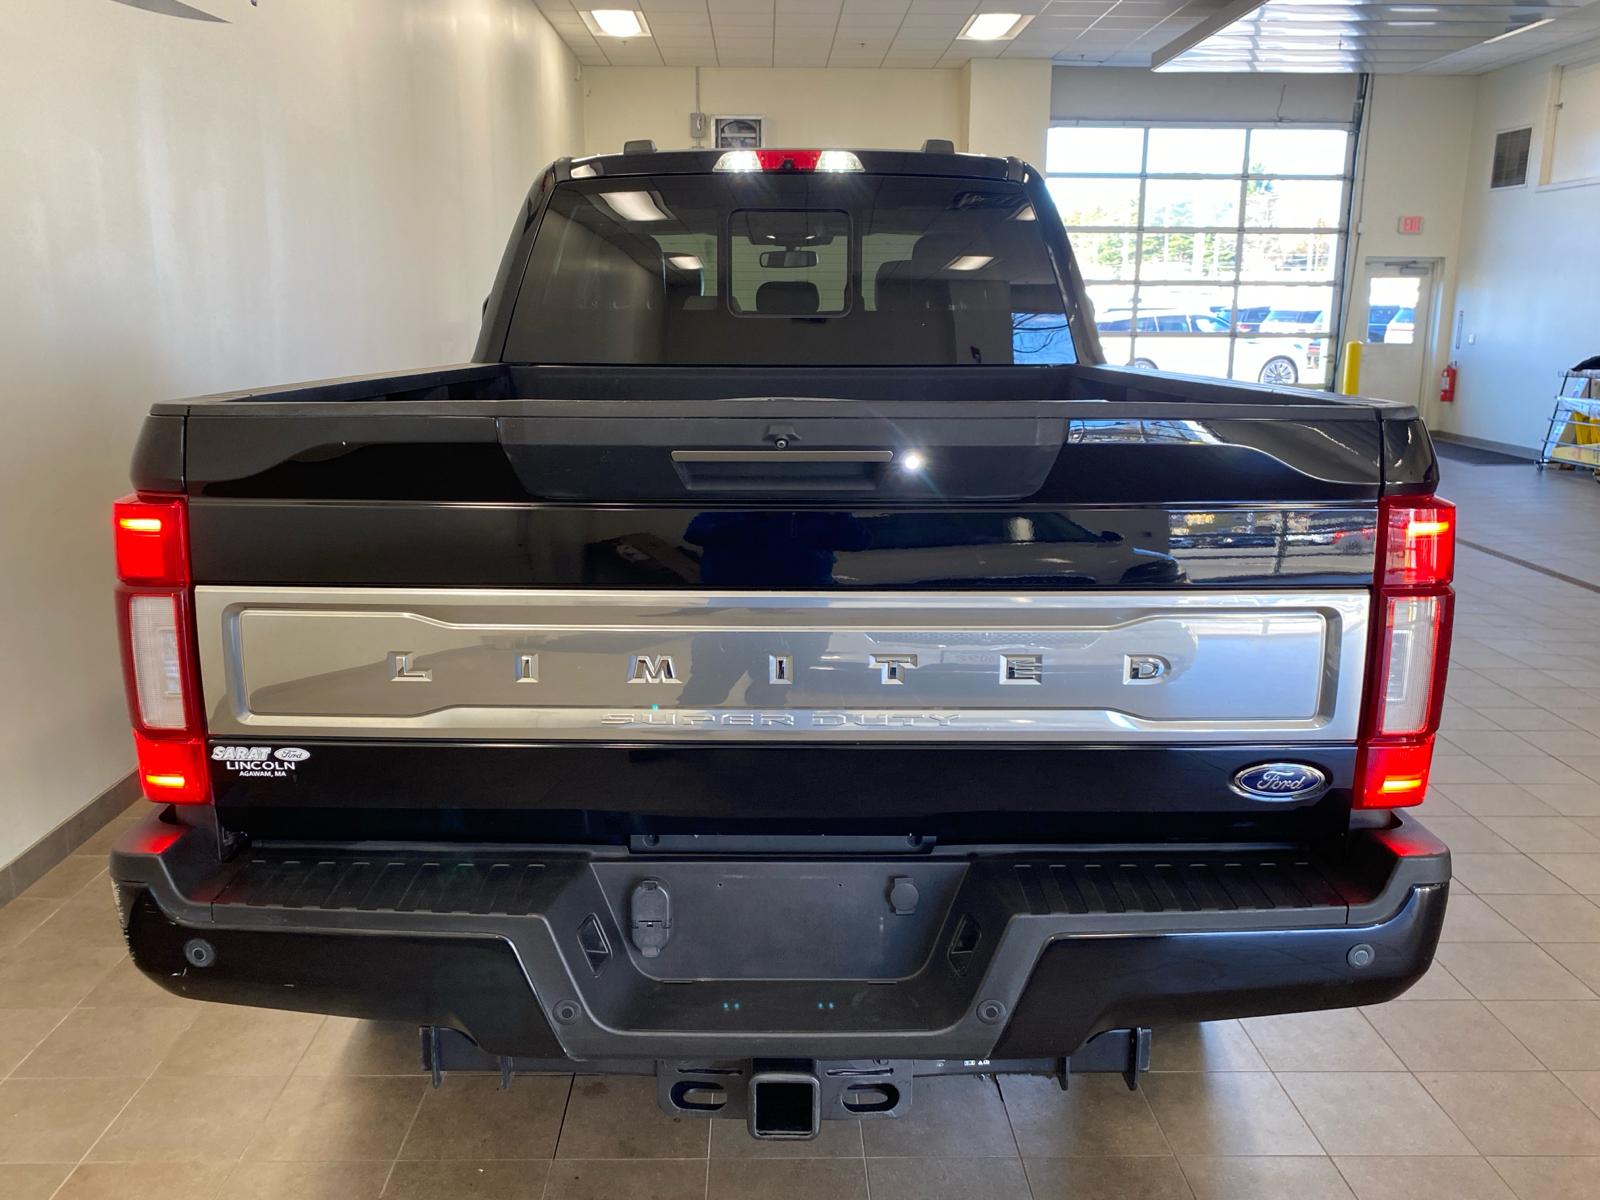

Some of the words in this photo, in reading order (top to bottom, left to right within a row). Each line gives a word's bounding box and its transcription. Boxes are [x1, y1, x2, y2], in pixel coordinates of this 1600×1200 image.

[1403, 216, 1422, 232] EXIT
[390, 651, 1171, 686] LIMITED
[601, 713, 794, 725] SUPER
[812, 713, 961, 726] DUTY
[211, 746, 271, 761] SARAT
[226, 761, 295, 770] LINCOLN
[1257, 770, 1306, 790] Ford
